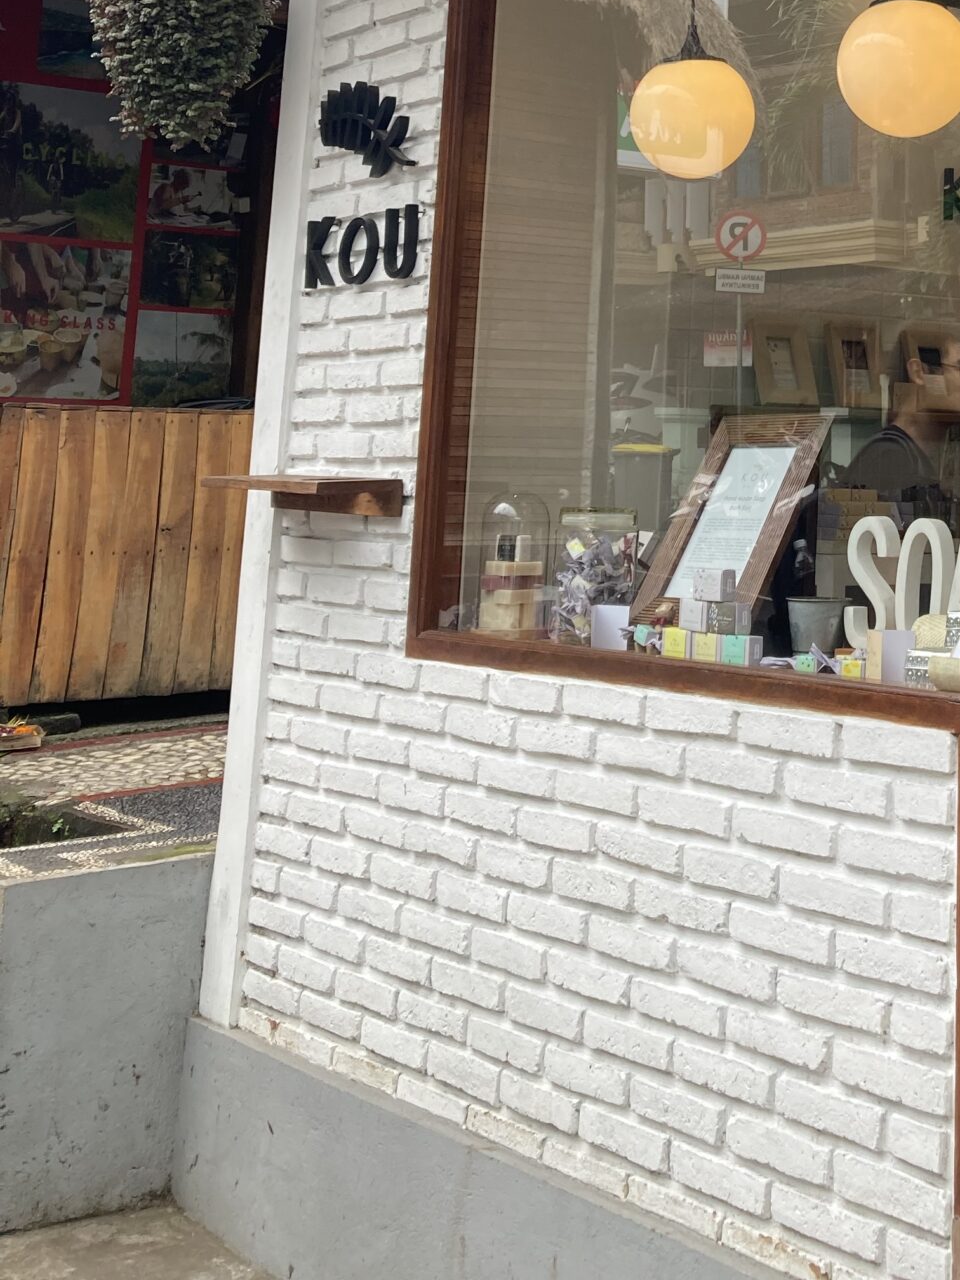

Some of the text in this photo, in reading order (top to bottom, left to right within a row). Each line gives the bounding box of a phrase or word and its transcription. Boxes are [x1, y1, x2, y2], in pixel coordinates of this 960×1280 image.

[22, 143, 126, 169] CYCLING
[305, 204, 420, 289] KOU
[60, 315, 116, 331] CLASS
